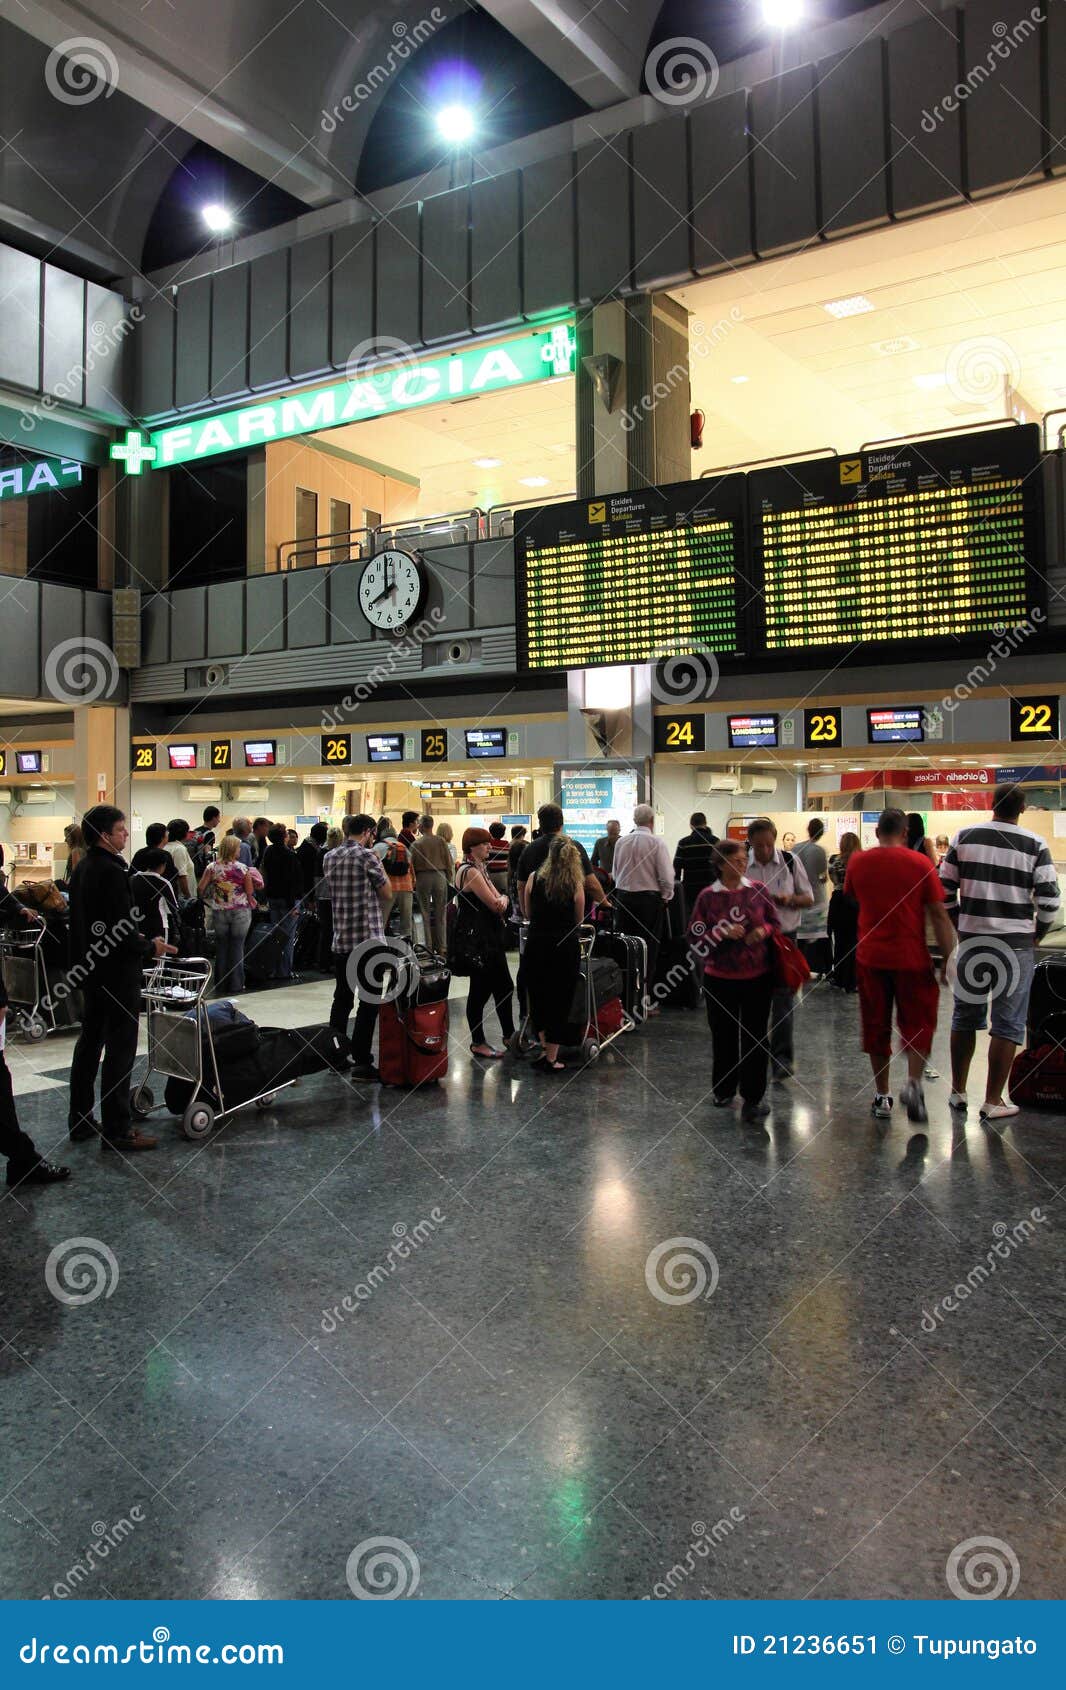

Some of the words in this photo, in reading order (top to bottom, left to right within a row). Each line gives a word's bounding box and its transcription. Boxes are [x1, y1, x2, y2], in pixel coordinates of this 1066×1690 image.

[161, 348, 524, 463] FARMACIA
[868, 460, 912, 473] Departures
[611, 504, 646, 514] Departures
[804, 506, 833, 517] MALAGA
[804, 518, 834, 529] BILBAO
[559, 542, 587, 553] COLONIA
[805, 540, 849, 552] BARCELONA
[376, 563, 381, 572] 11
[399, 560, 402, 569] 1
[406, 568, 411, 578] 2
[806, 565, 835, 575] MADRID
[367, 574, 375, 584] 10
[560, 573, 584, 583] BILBAO
[806, 576, 835, 587] MADRID
[409, 583, 415, 592] 3
[365, 589, 370, 598] 9
[368, 602, 373, 611] 8
[405, 597, 411, 606] 4
[807, 600, 836, 610] BILBAO
[377, 611, 382, 621] 7
[386, 614, 392, 623] 6
[397, 609, 403, 619] 5
[807, 611, 836, 621] LISBOA
[807, 624, 837, 634] LISBOA
[1020, 705, 1051, 732] 22
[667, 722, 694, 744] 24
[811, 716, 836, 740] 23
[327, 740, 346, 759] 26
[426, 736, 443, 755] 25
[137, 749, 152, 766] 28
[215, 746, 228, 764] 27
